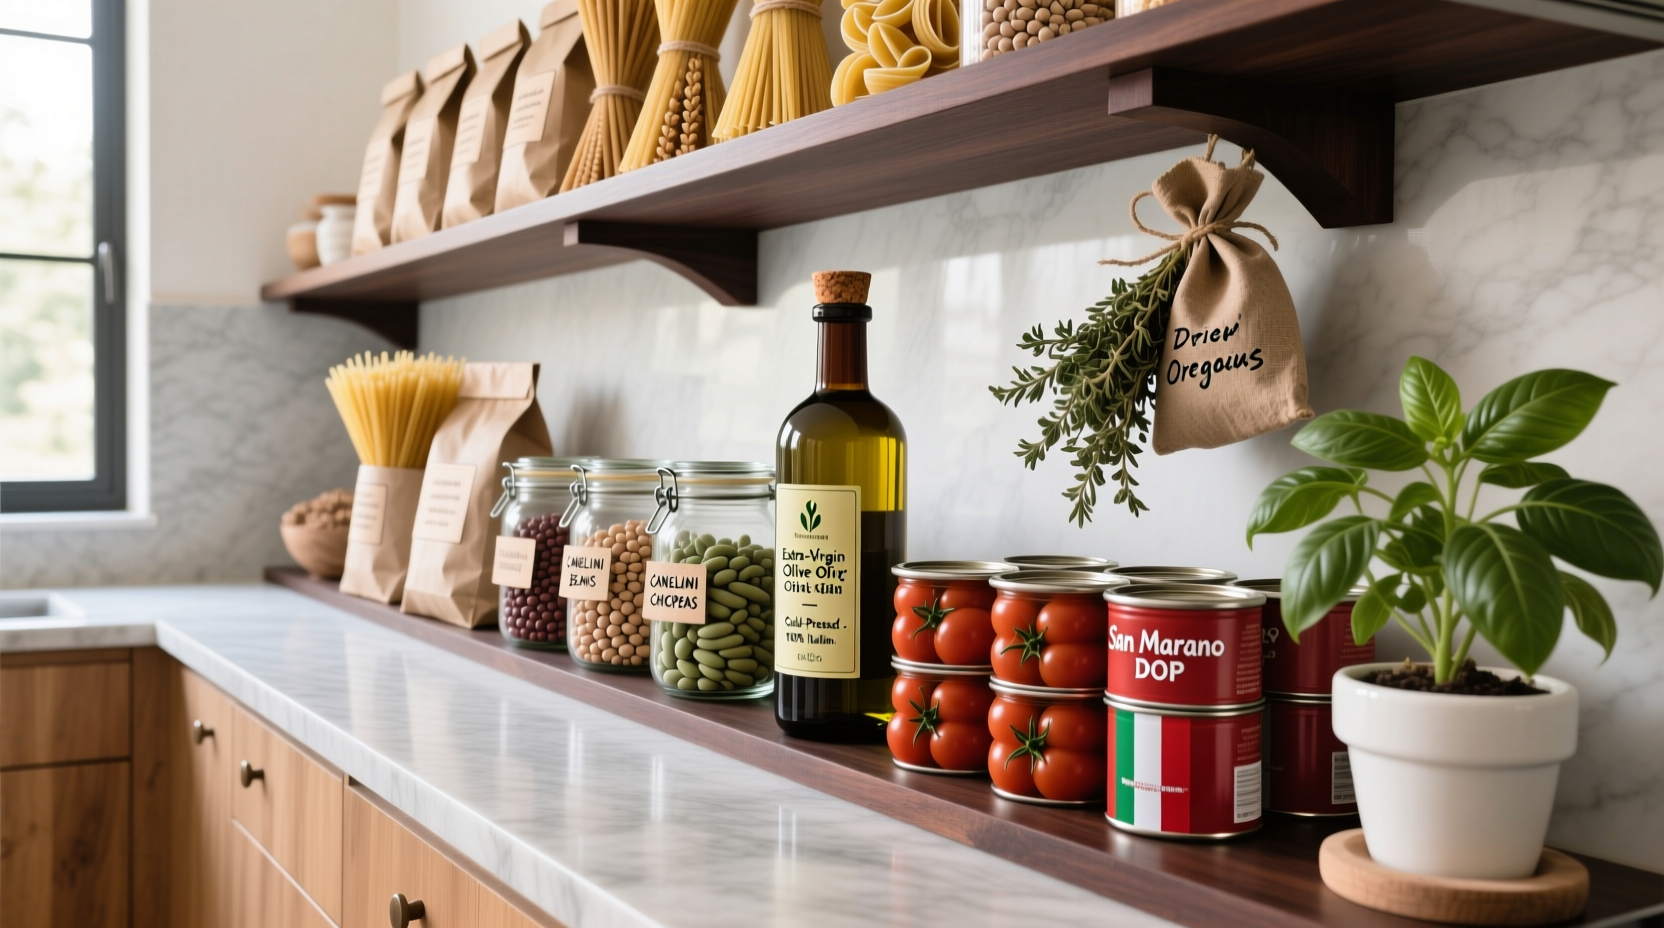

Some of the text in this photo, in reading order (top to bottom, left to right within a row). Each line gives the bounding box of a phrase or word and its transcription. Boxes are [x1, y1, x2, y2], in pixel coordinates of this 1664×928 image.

[649, 573, 699, 590] CANELINI
[782, 563, 812, 579] Olive
[1107, 624, 1226, 658] San Marano
[1134, 657, 1186, 683] DOP
